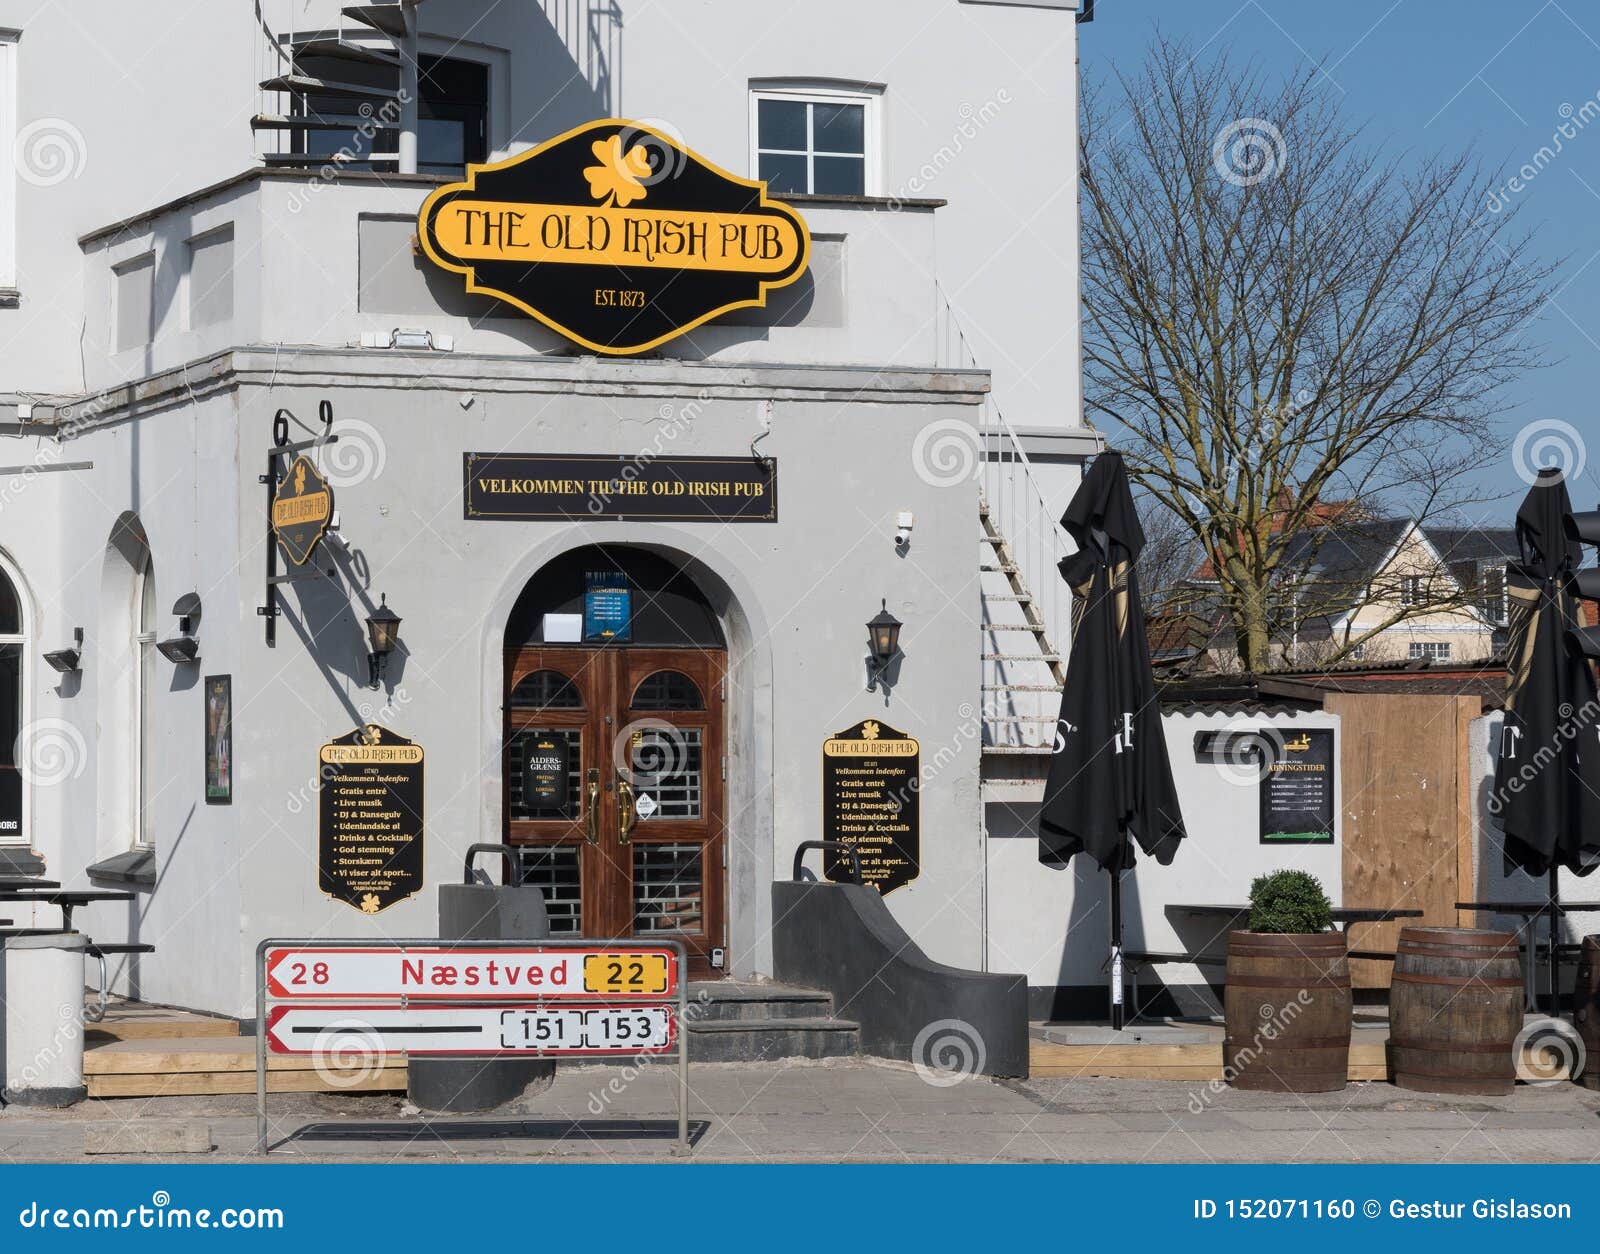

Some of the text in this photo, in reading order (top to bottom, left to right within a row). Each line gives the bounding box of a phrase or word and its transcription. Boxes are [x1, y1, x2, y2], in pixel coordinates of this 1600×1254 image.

[456, 209, 784, 262] THE OLD IRISH PUB
[595, 290, 646, 307] EST. 1873
[478, 479, 764, 497] VELKOMMEN TIL THE OLD IRISH PUB
[830, 743, 913, 755] THE OLD IRISH PUB
[327, 749, 418, 761] THE OLD IRISH PUB
[530, 756, 562, 764] ALDERS-
[530, 763, 562, 771] GRÆNSE
[366, 787, 387, 795] entré
[339, 799, 383, 807] Live musik
[841, 802, 850, 810] DJ
[860, 802, 898, 811] Dansegulv
[339, 811, 348, 819] DJ
[360, 811, 401, 820] Dansegulv
[841, 813, 889, 821] Udenlandske
[0, 820, 17, 830] ORG
[339, 822, 391, 830] Udenlandske
[339, 834, 366, 842] Drinks
[376, 834, 413, 842] Cocktails
[858, 836, 893, 845] stemning
[357, 846, 395, 855] stemning
[339, 869, 347, 877] Vi
[349, 869, 368, 877] viser
[370, 869, 381, 877] alt
[291, 959, 645, 986] 28 Næstved 22
[521, 1016, 652, 1041] 151 153
